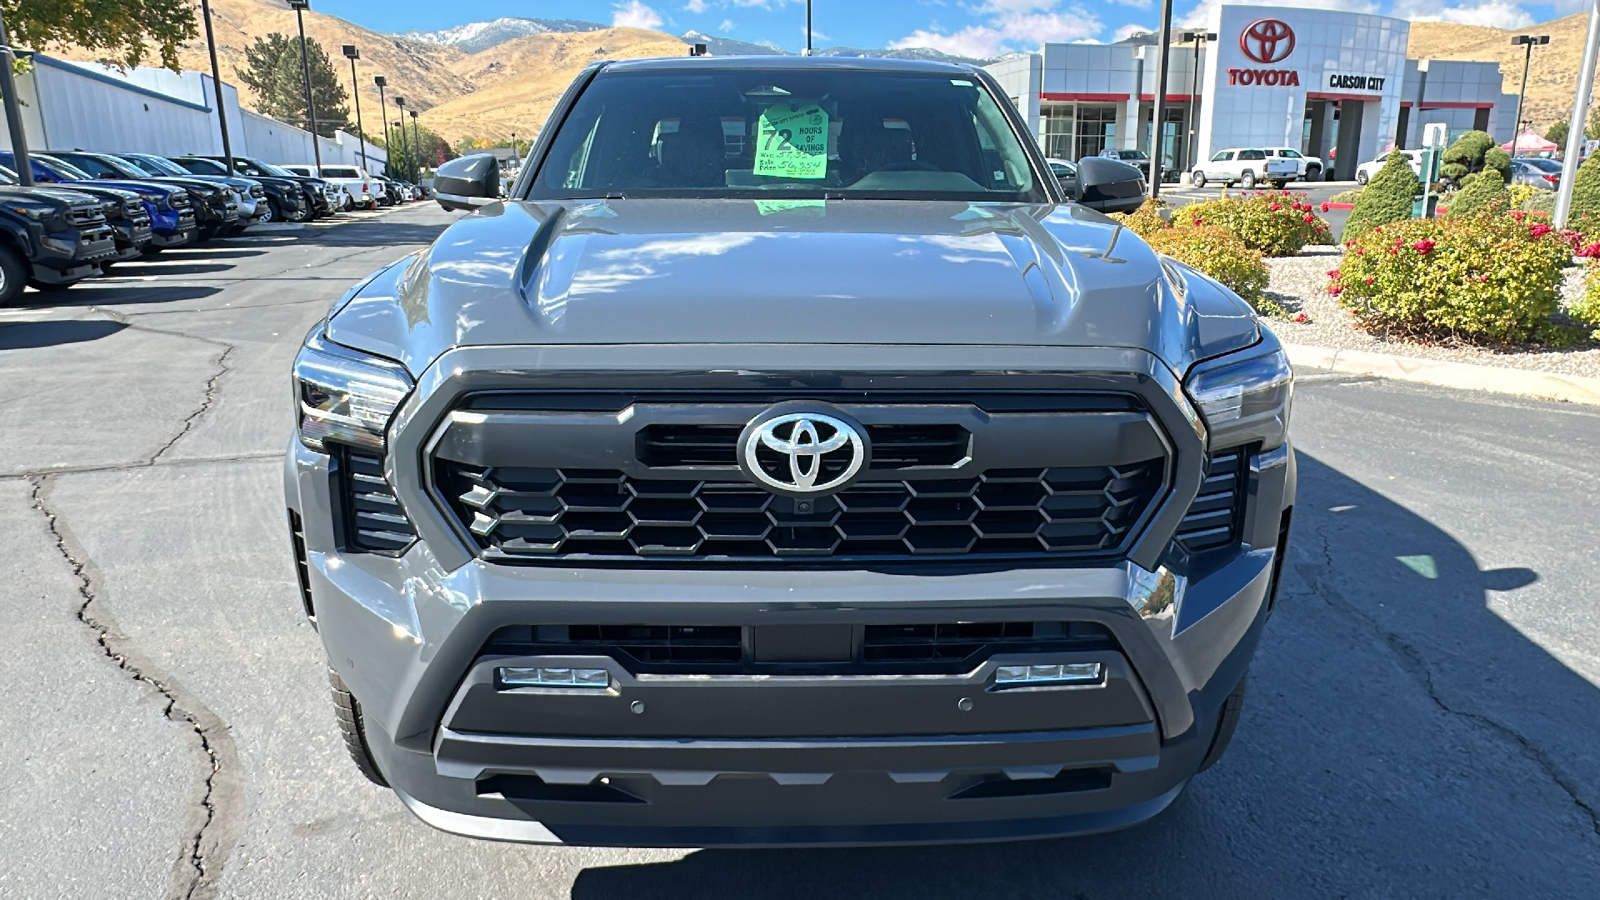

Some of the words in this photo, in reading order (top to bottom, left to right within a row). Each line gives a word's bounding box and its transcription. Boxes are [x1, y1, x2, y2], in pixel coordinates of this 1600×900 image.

[1228, 68, 1300, 87] TOYOTA
[1329, 74, 1366, 90] CARSON
[1367, 77, 1385, 91] CITY
[763, 129, 792, 150] 72
